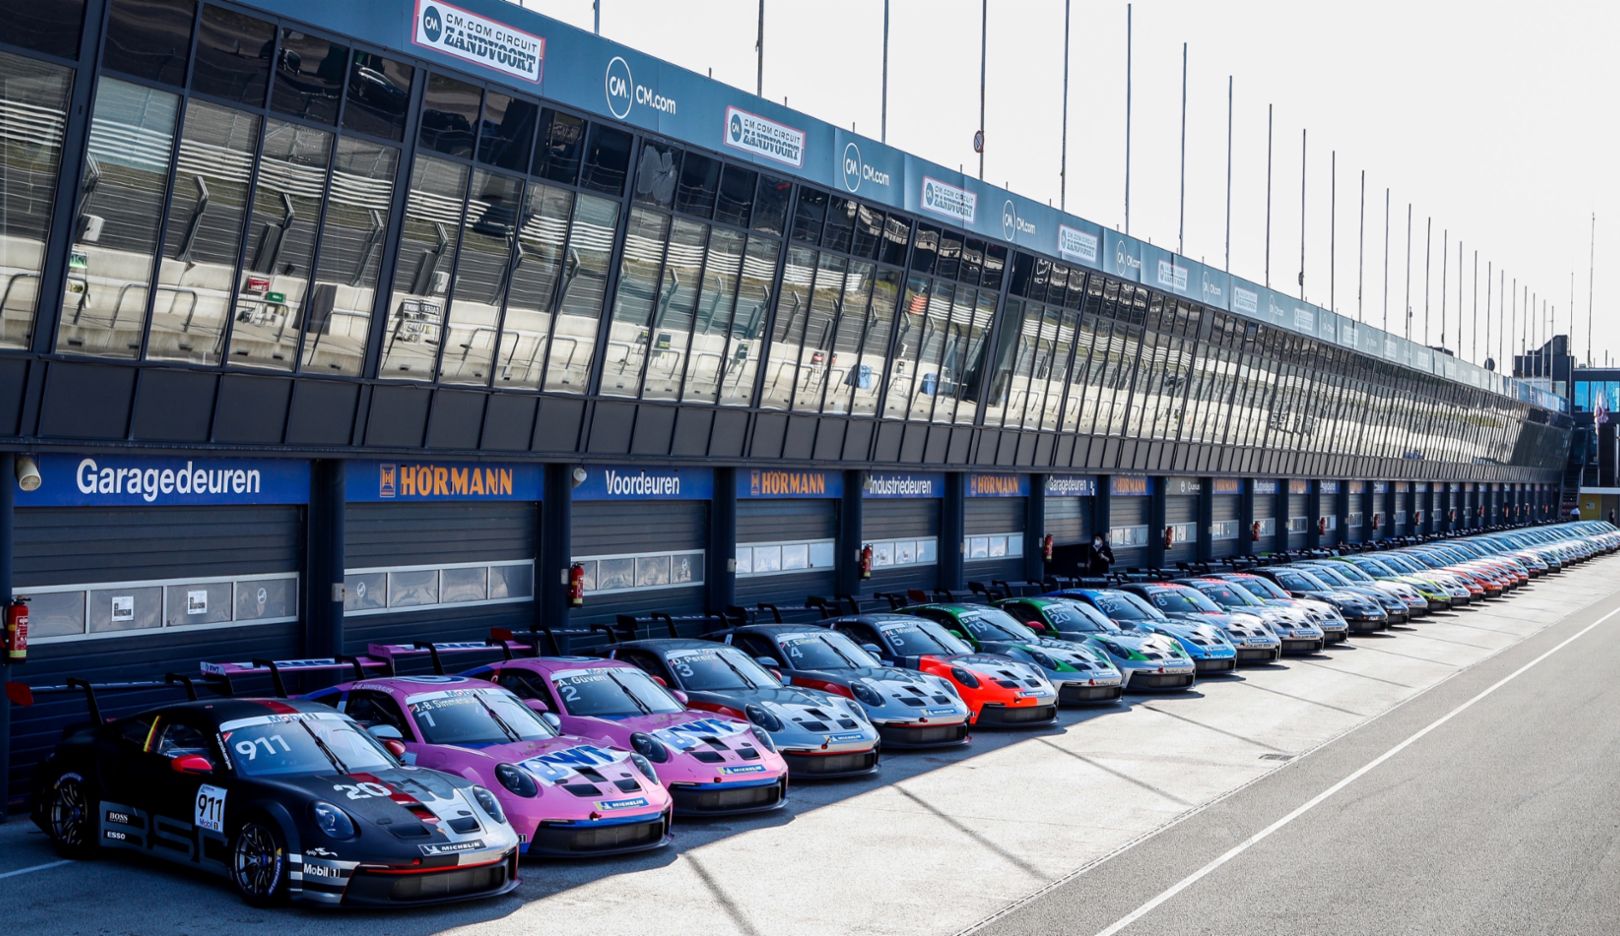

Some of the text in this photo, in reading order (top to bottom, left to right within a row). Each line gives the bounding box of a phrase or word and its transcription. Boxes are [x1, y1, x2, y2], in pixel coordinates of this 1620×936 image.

[446, 13, 538, 53] CM.COM CIRCUIT
[443, 25, 536, 74] ZANDVOORT
[635, 84, 677, 115] CM.com
[744, 118, 801, 144] CM.COM CIRCUIT
[742, 127, 800, 161] ZANDVOORT
[862, 163, 890, 187] CM.com
[76, 458, 261, 502] Garagedeuren
[400, 464, 513, 496] HÖRMANN
[605, 468, 680, 495] Voordeuren
[761, 471, 825, 495] HÖRMANN
[869, 474, 932, 495] Industriedeuren
[1048, 474, 1087, 495] Garagedeuren
[968, 621, 988, 633] 19
[1049, 612, 1071, 625] 20
[889, 634, 905, 647] 5
[790, 646, 804, 659] 4
[676, 663, 695, 678] 3
[561, 685, 582, 703] 2
[418, 710, 437, 728] 1
[235, 734, 292, 761] 911
[517, 745, 615, 783] BWT
[333, 781, 392, 801] 20
[109, 812, 128, 821] BOSS
[198, 794, 223, 823] 911
[107, 830, 126, 841] ESSO
[440, 841, 482, 852] MICHELIN
[303, 863, 329, 878] Mobil
